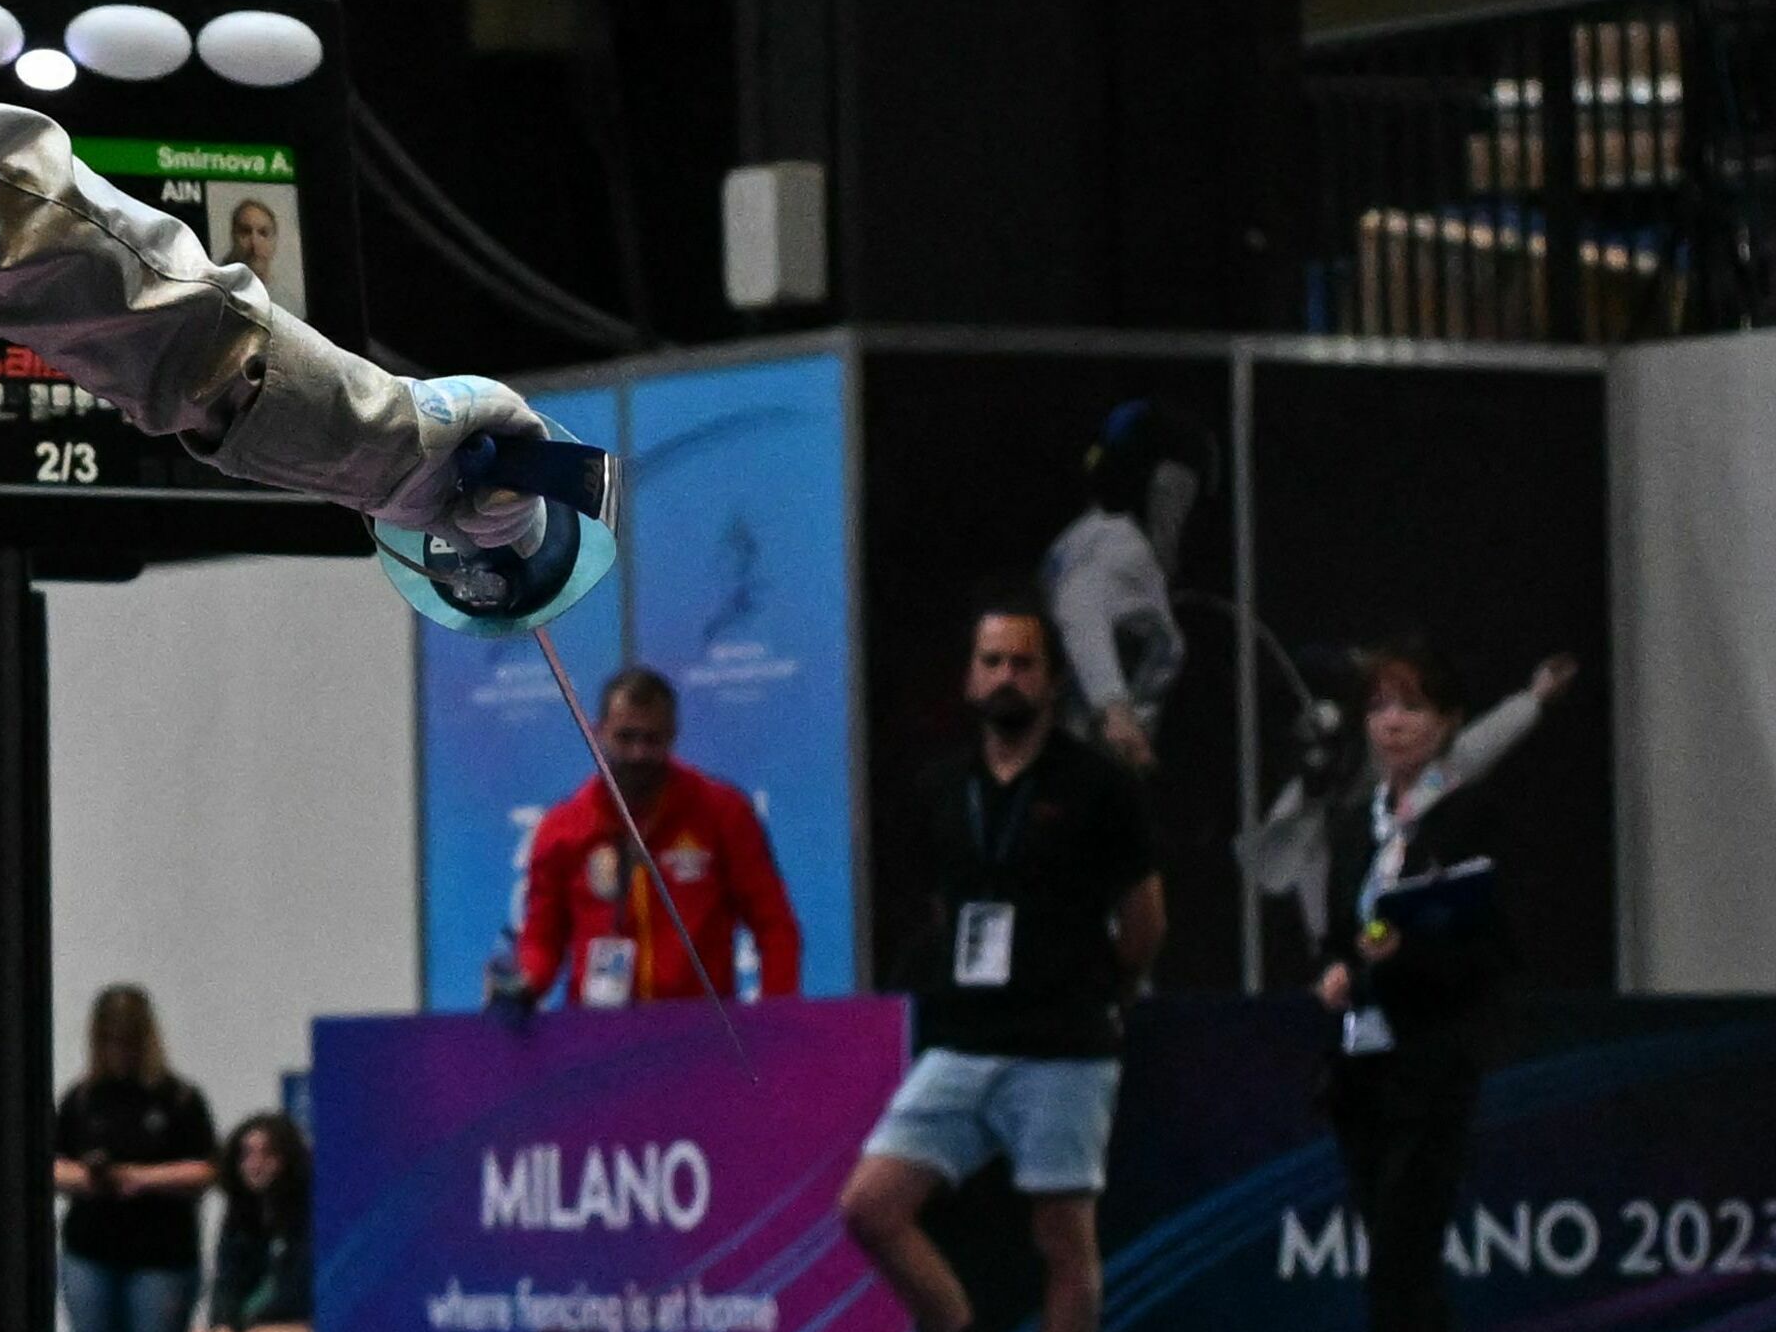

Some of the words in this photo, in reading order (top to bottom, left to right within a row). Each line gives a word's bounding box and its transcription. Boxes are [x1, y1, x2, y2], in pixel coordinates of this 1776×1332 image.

[157, 143, 266, 175] Smirnova
[160, 179, 203, 204] AIN
[34, 441, 99, 483] 2/3
[482, 1140, 710, 1231] MILANO
[1278, 1199, 1602, 1281] MIANO
